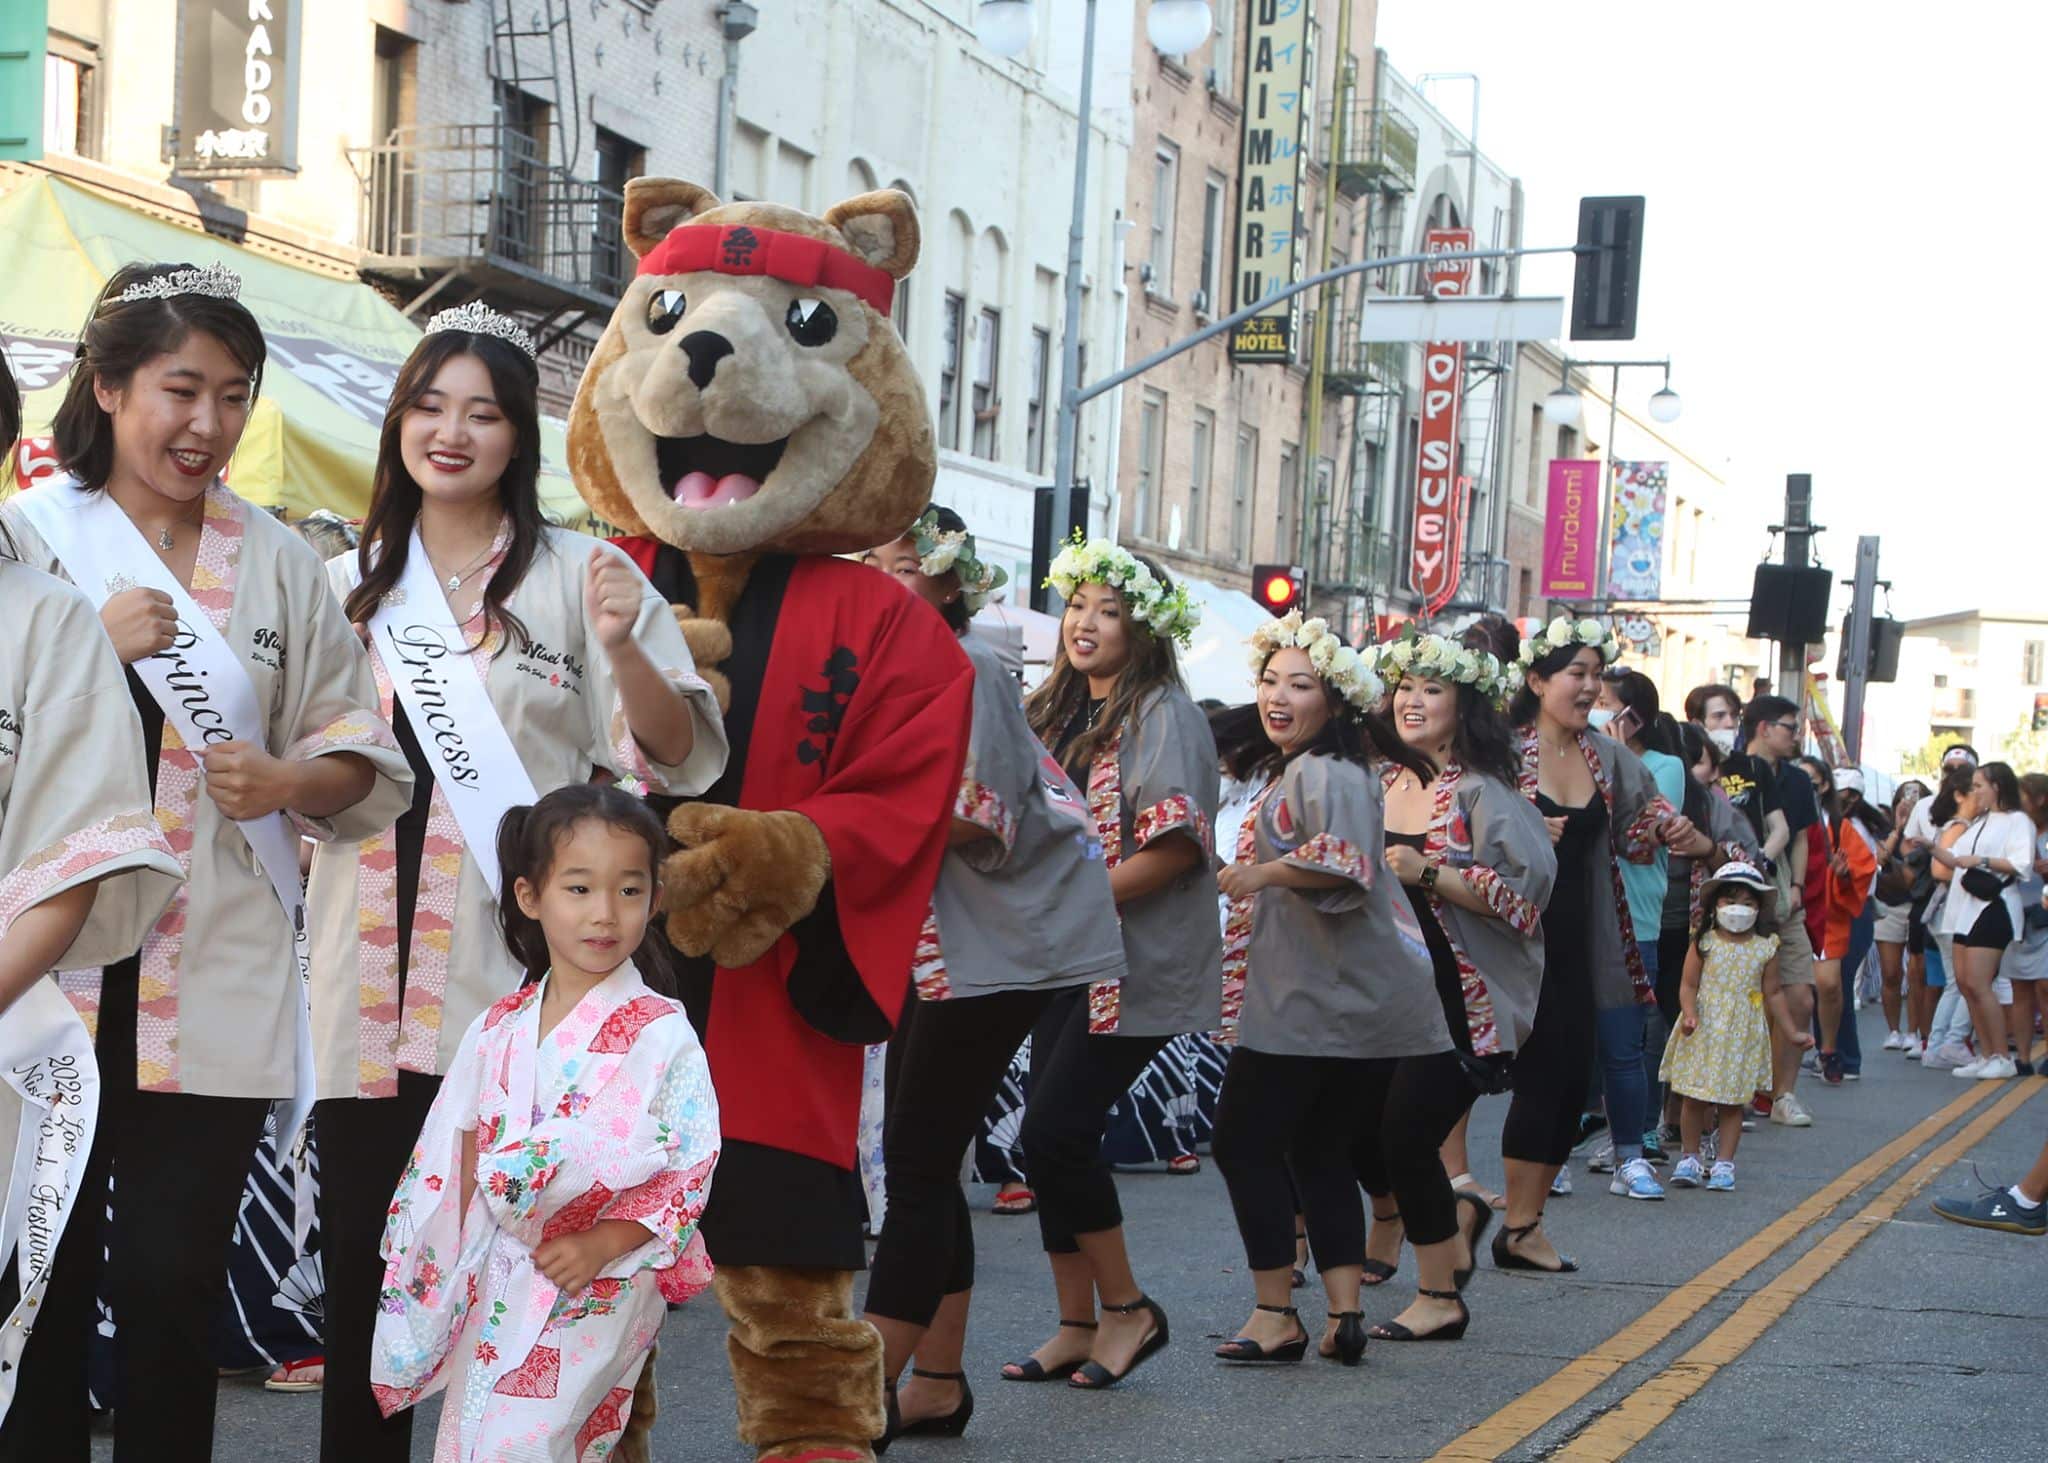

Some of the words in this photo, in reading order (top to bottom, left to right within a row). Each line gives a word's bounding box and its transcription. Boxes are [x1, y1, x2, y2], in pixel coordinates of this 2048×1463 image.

[1235, 333, 1286, 350] HOTEL
[1425, 279, 1460, 419] COP
[1416, 440, 1449, 579] SUEY
[1561, 468, 1583, 577] murakami
[151, 617, 233, 744] Prince
[387, 623, 480, 792] Princess
[12, 1062, 54, 1105] Nis
[48, 1055, 82, 1106] 2022
[54, 1113, 85, 1158] Los
